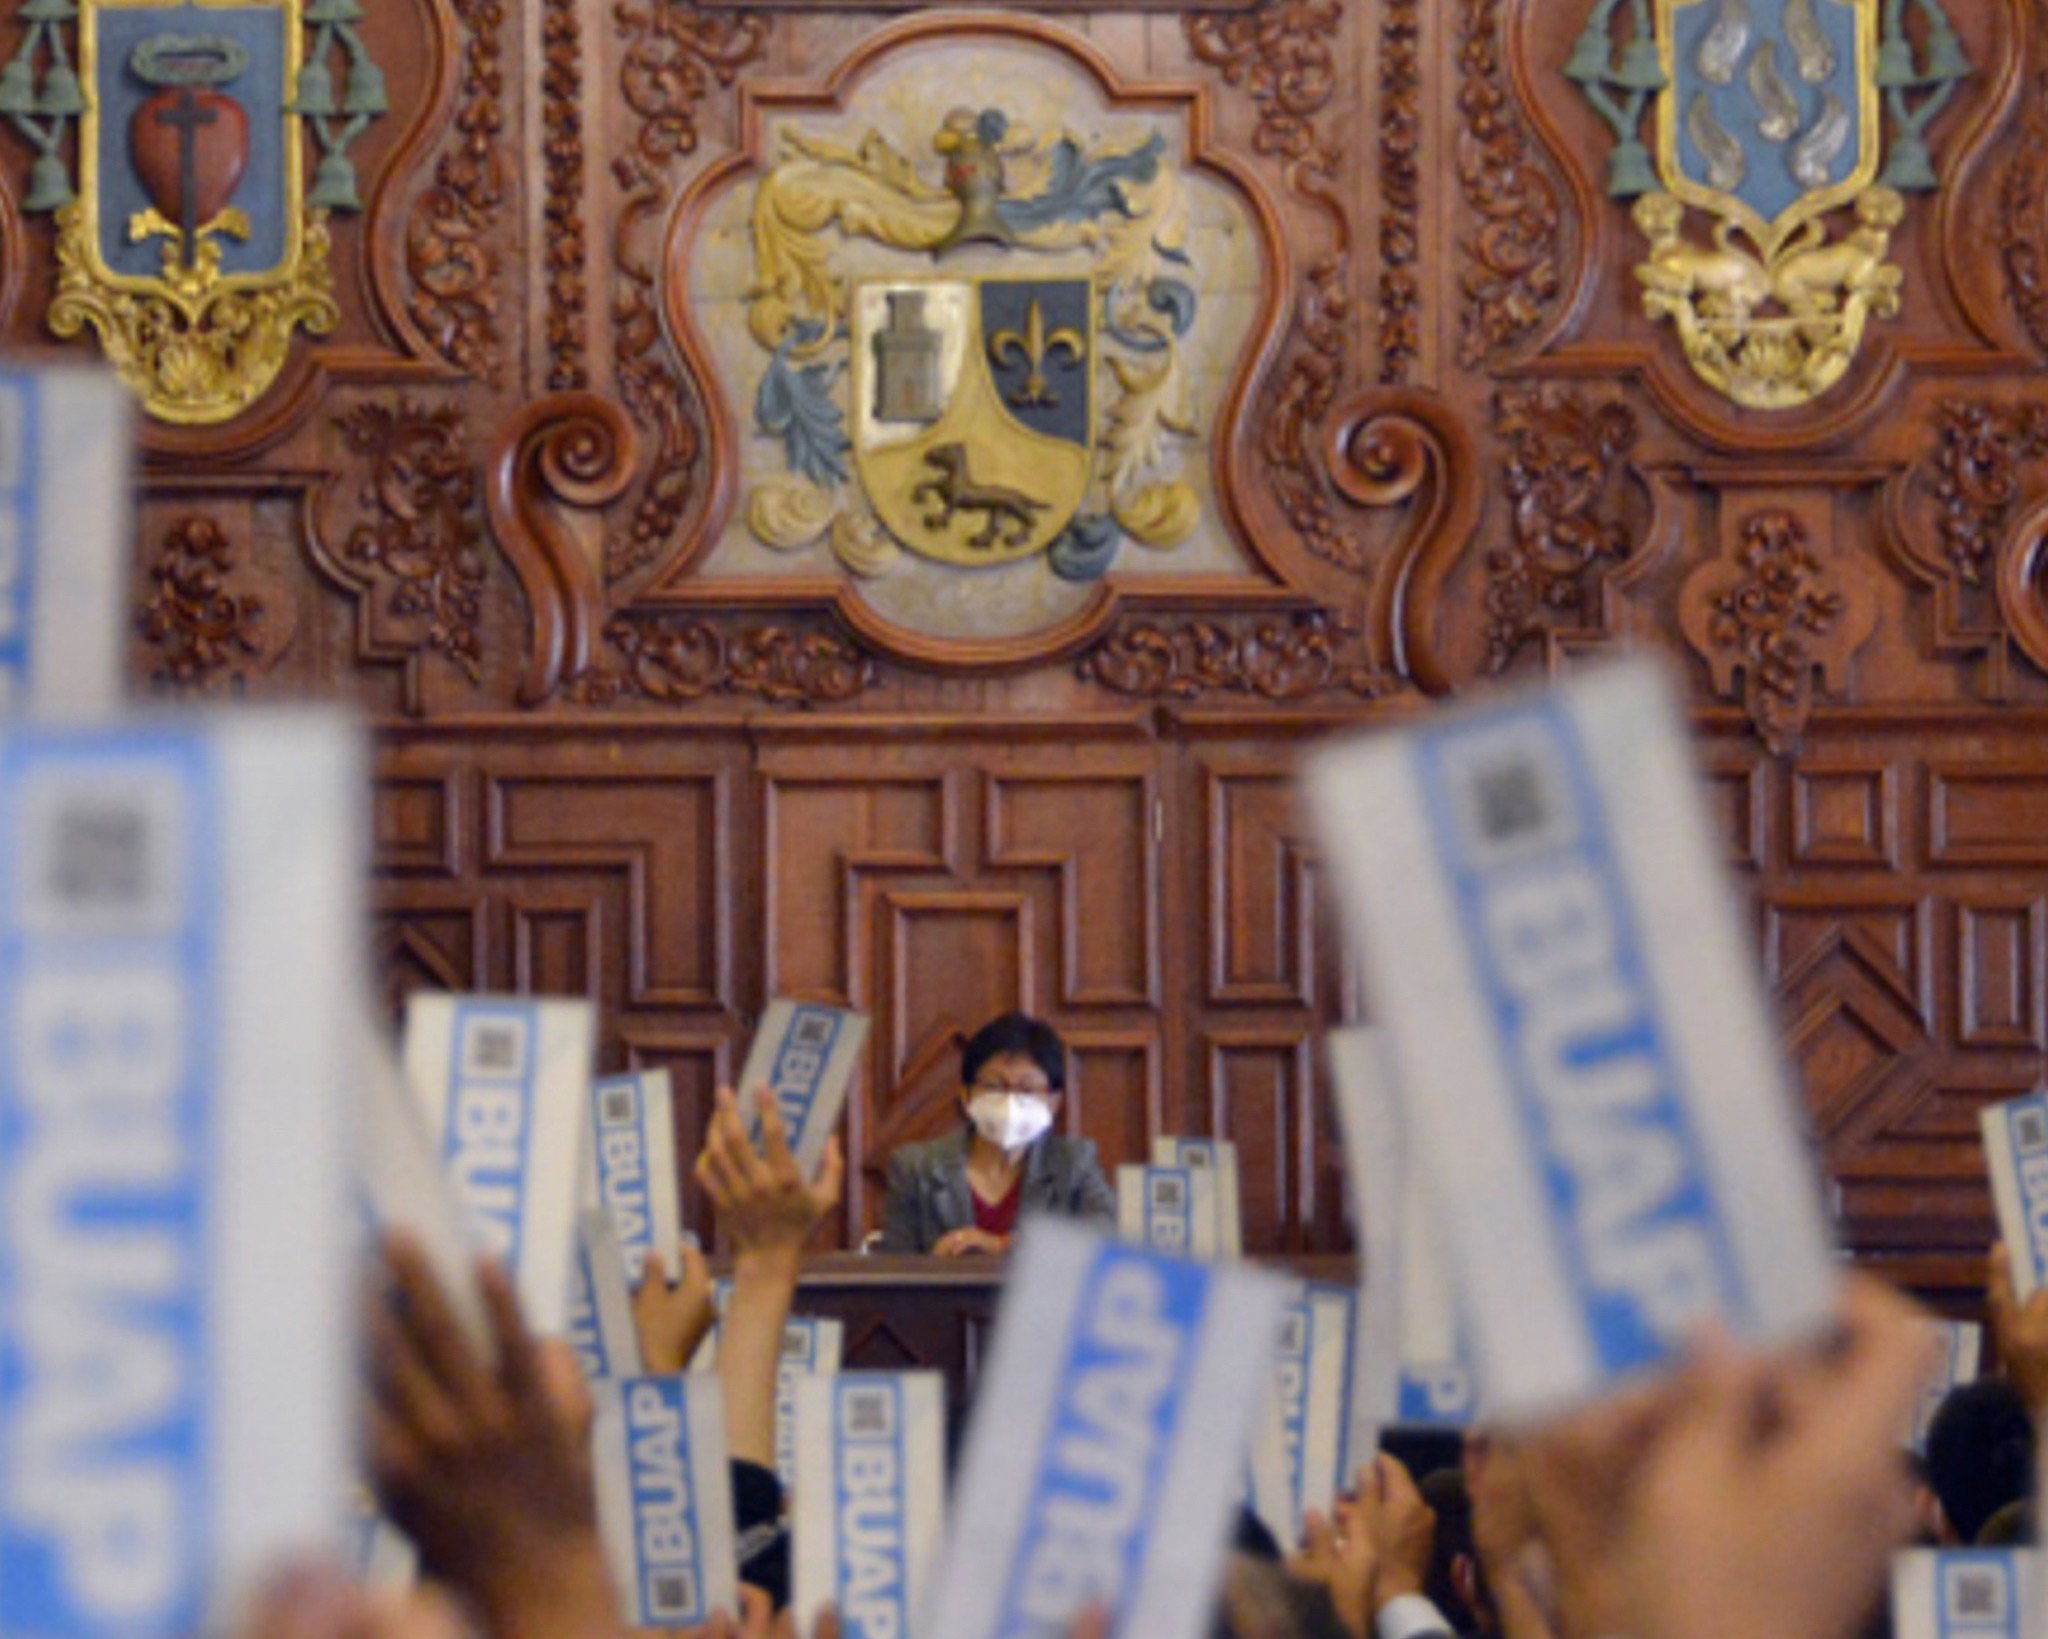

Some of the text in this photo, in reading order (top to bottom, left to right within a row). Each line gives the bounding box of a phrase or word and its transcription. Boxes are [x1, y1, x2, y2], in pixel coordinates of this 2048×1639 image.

[1487, 870, 1722, 1335] BUAP
[15, 970, 186, 1622] BUAP
[630, 1384, 691, 1564] BUAP
[1021, 1262, 1183, 1622] BUAP
[842, 1443, 898, 1639] BUAP
